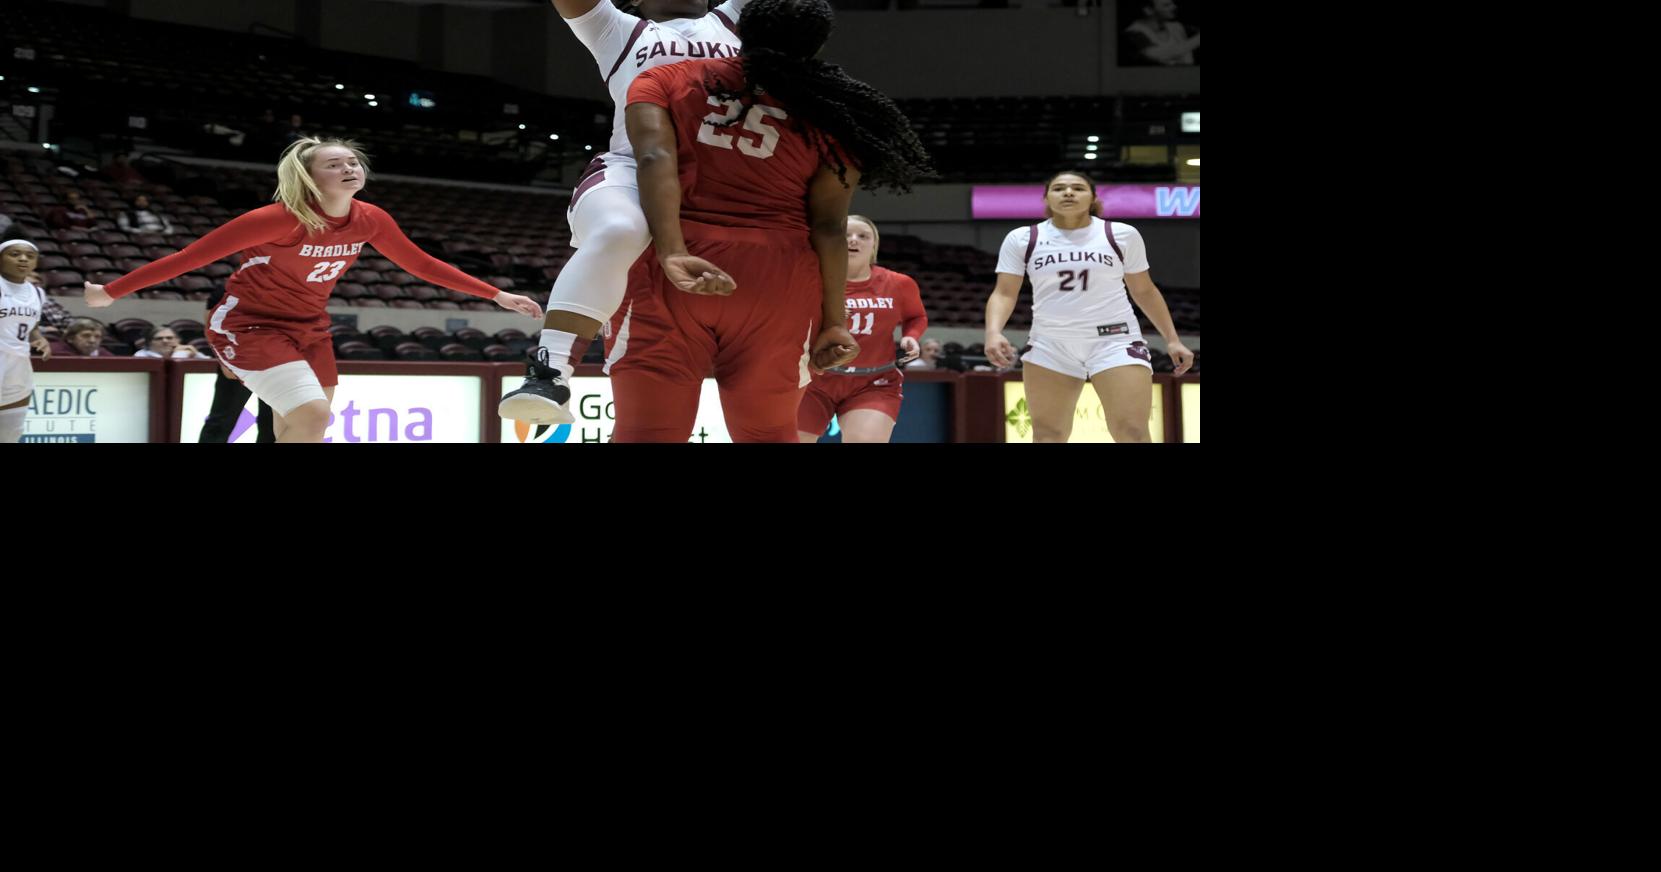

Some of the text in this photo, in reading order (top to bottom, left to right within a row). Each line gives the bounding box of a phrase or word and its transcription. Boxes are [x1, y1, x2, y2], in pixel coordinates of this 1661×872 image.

[697, 93, 788, 159] 25
[306, 260, 346, 283] 23
[1034, 251, 1113, 270] SALUKIS
[1057, 269, 1090, 292] 21
[845, 297, 894, 309] ADLEY
[849, 312, 875, 335] 11
